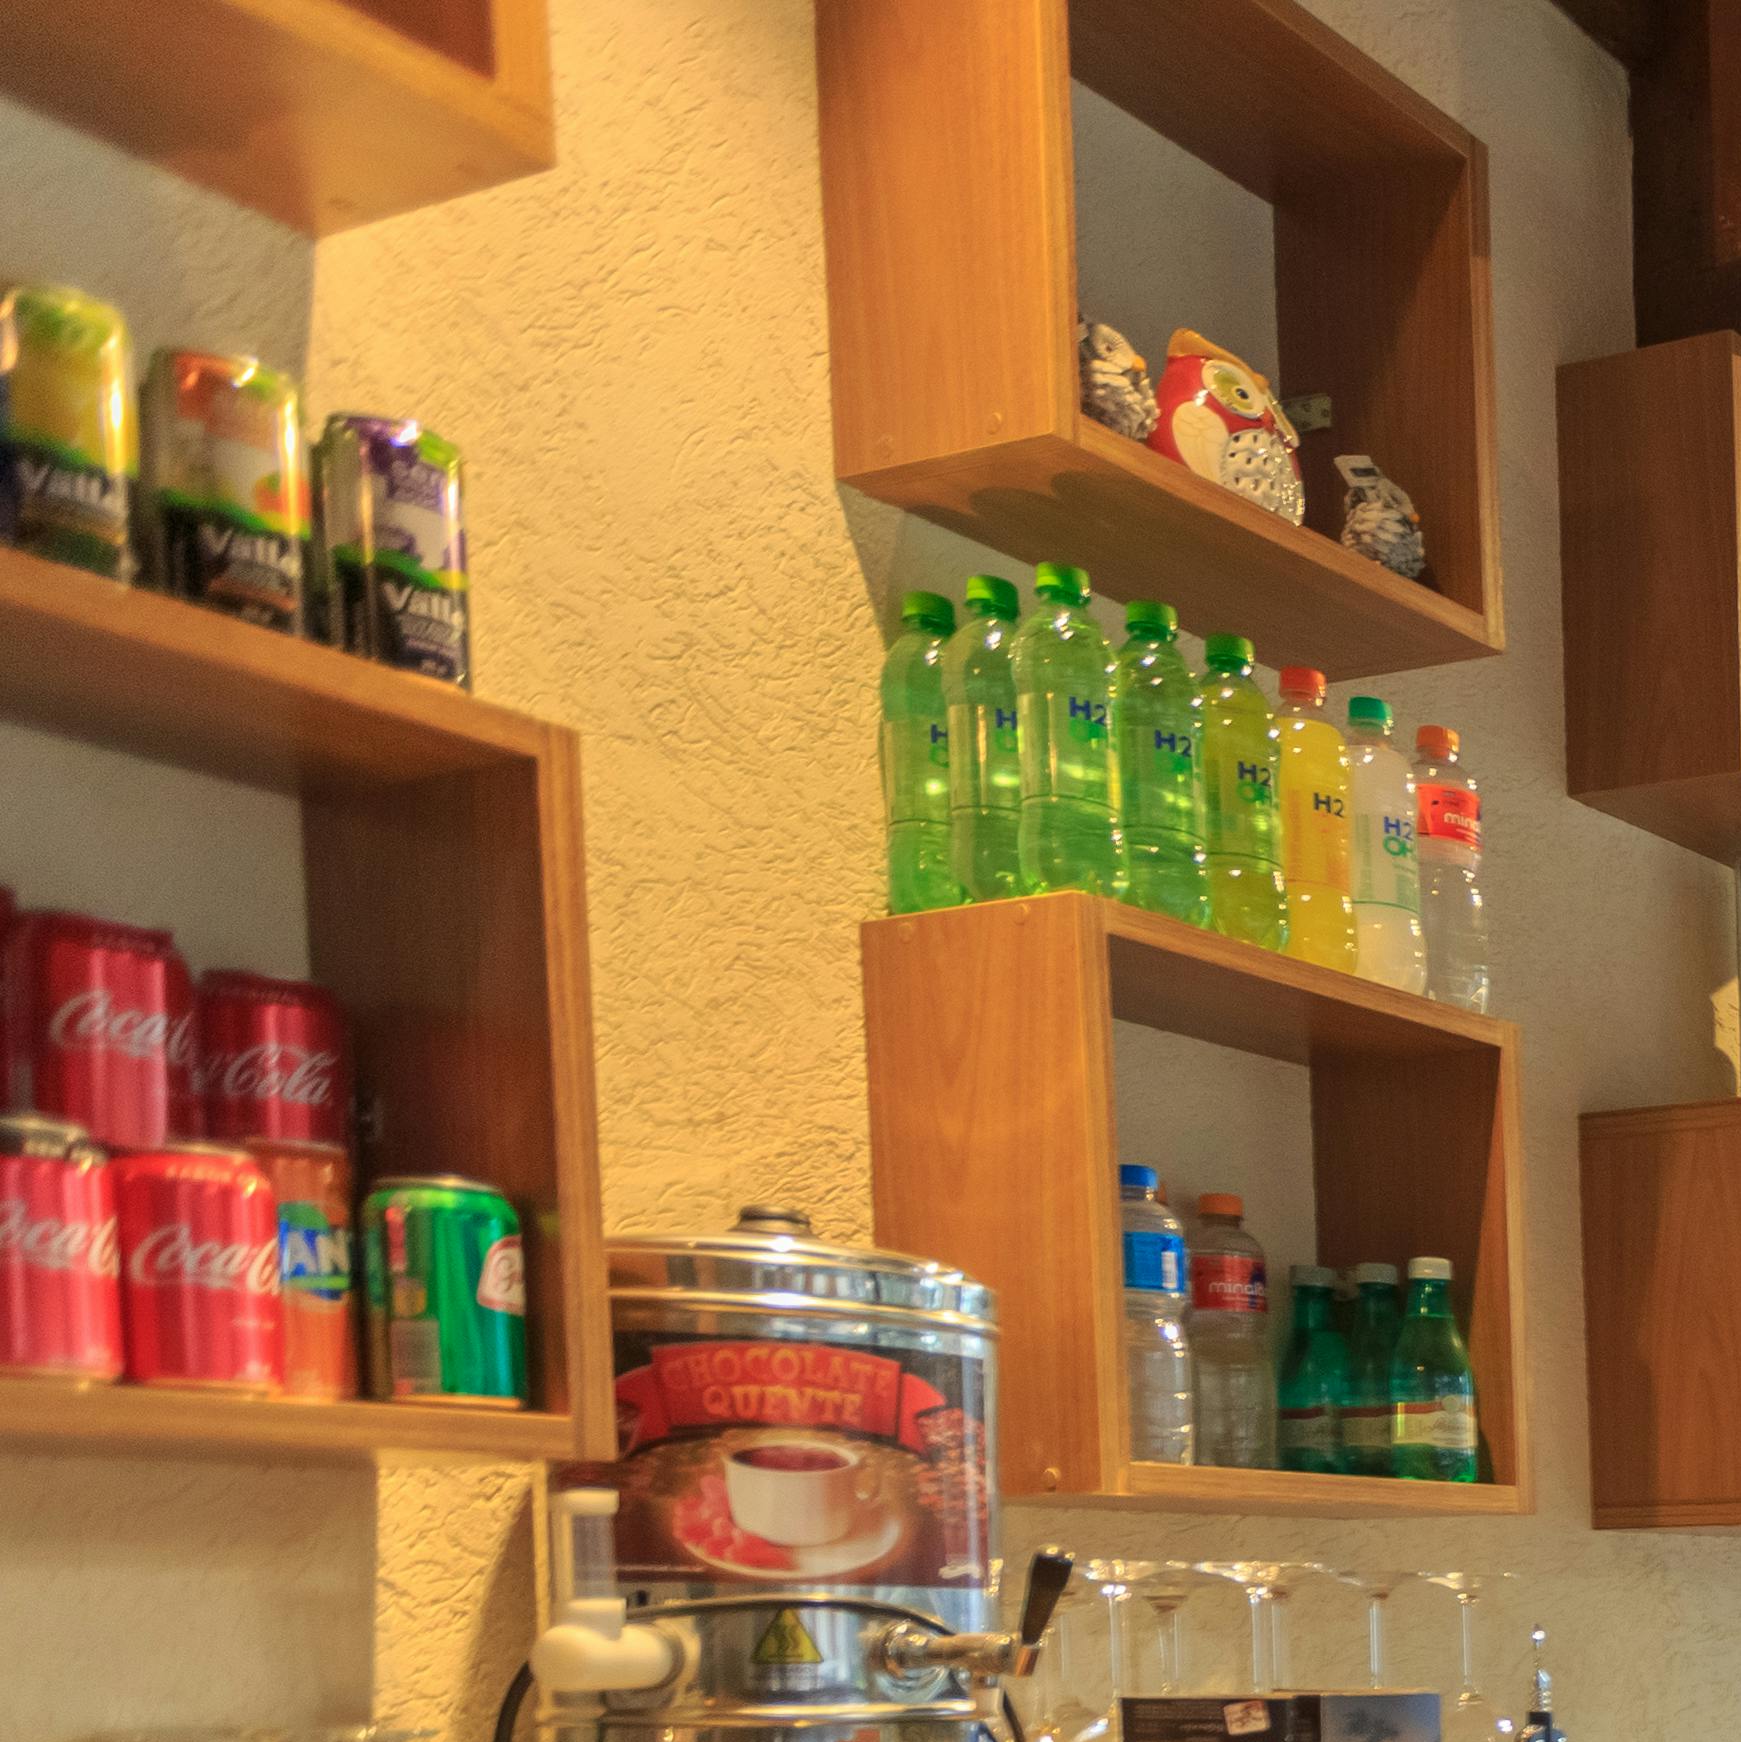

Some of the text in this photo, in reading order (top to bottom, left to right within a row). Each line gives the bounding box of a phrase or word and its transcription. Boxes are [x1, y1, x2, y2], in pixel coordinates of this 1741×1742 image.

[1237, 760, 1272, 788] H2
[1313, 792, 1345, 819] H2
[1384, 815, 1414, 842] H2
[661, 1347, 894, 1398] CHOCOLATE
[702, 1383, 864, 1423] QUENTE
